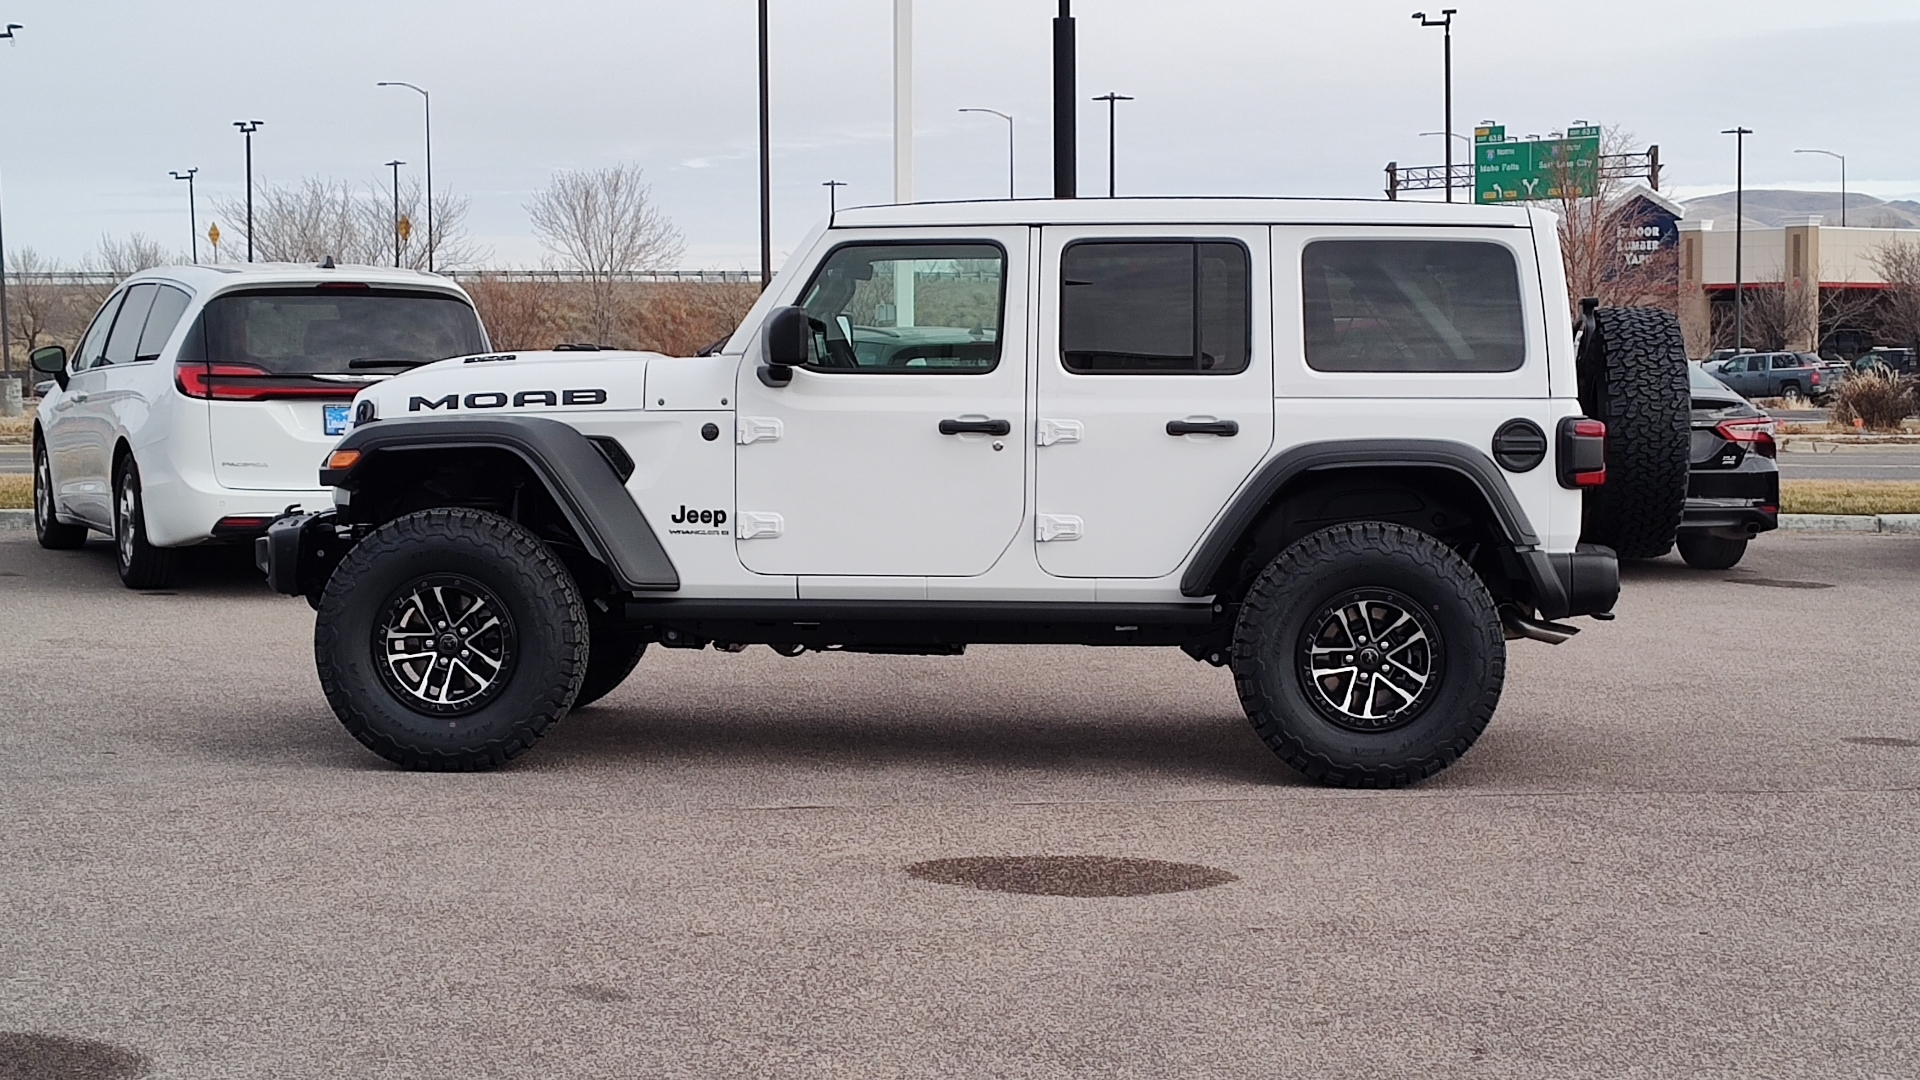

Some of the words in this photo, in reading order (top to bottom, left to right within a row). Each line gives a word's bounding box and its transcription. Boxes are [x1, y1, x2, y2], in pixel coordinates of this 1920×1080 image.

[1480, 164, 1500, 172] Idaho
[1501, 163, 1520, 172] Falls
[408, 388, 608, 412] MOAB
[671, 505, 727, 528] Jeep
